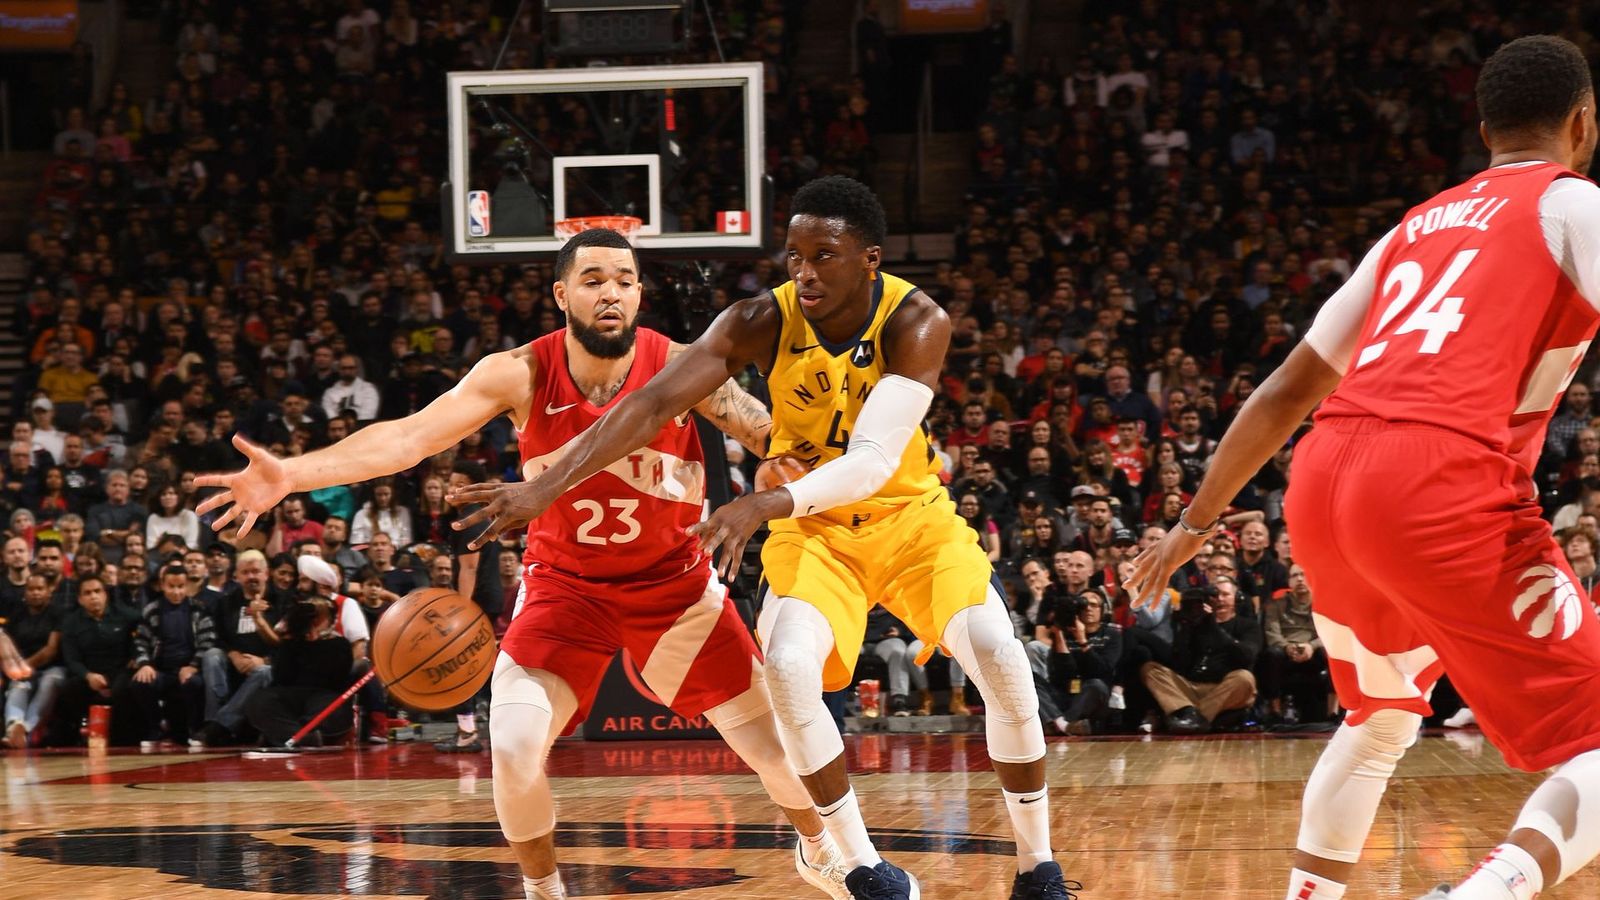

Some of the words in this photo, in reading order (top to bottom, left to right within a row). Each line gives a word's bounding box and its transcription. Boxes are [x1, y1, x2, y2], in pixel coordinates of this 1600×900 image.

[1406, 197, 1509, 244] POWELL
[1355, 248, 1480, 369] 24
[825, 410, 850, 455] 4
[571, 498, 642, 546] 23
[602, 717, 645, 732] AIR
[650, 715, 714, 731] CAN
